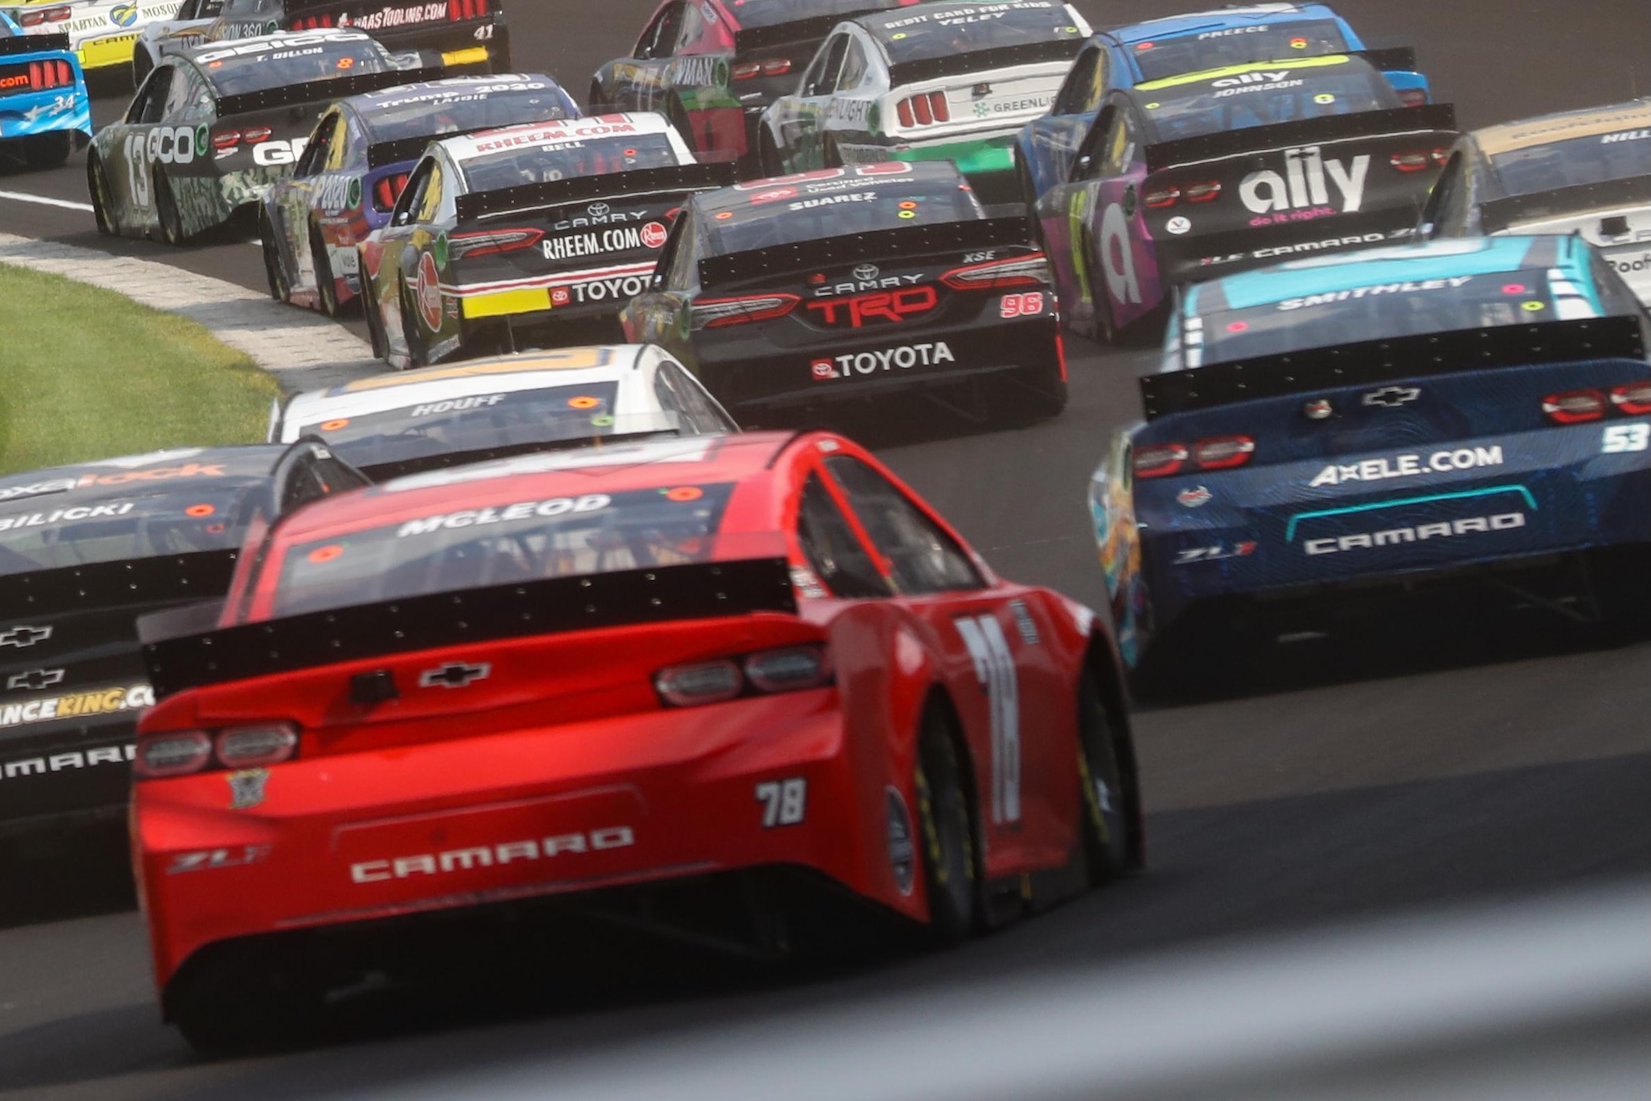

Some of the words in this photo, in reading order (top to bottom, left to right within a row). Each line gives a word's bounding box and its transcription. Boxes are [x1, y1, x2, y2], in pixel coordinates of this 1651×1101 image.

[142, 2, 186, 20] MOSQU
[933, 8, 977, 21] CARD
[978, 3, 1011, 14] FOR
[938, 11, 1007, 27] YELEY
[57, 15, 108, 34] SPARTAN
[473, 24, 494, 41] 41
[1198, 24, 1270, 41] PREECE
[195, 32, 370, 64] GEICO
[256, 53, 269, 62] T.
[272, 46, 324, 61] DILLON
[474, 81, 546, 95] 2020
[1210, 70, 1290, 90] ally
[54, 94, 76, 110] 34
[993, 95, 1056, 114] GREENLI
[475, 122, 636, 153] RHEEM.COM
[541, 140, 586, 153] BELL
[1239, 146, 1371, 214] ally
[788, 190, 878, 213] SUAREZ
[554, 209, 648, 230] CAMRY
[1249, 214, 1271, 228] do
[1273, 212, 1289, 224] it
[542, 227, 641, 260] RHEEM.COM
[1253, 232, 1385, 260] CAMARO
[963, 250, 996, 264] XSE
[571, 274, 654, 302] TOYOT
[814, 272, 925, 297] CAMRY
[1275, 276, 1474, 311] SMITHLEY
[806, 285, 937, 328] TRD
[999, 292, 1044, 318] 96
[835, 341, 955, 378] TOYOTA
[411, 391, 506, 419] HOUFF
[1600, 422, 1651, 455] 53
[1308, 444, 1504, 488] AXELE.COM
[396, 492, 612, 539] MCLEOD
[1304, 510, 1525, 557] CAMARO
[755, 777, 807, 829] 78
[350, 824, 636, 885] CAMARO
